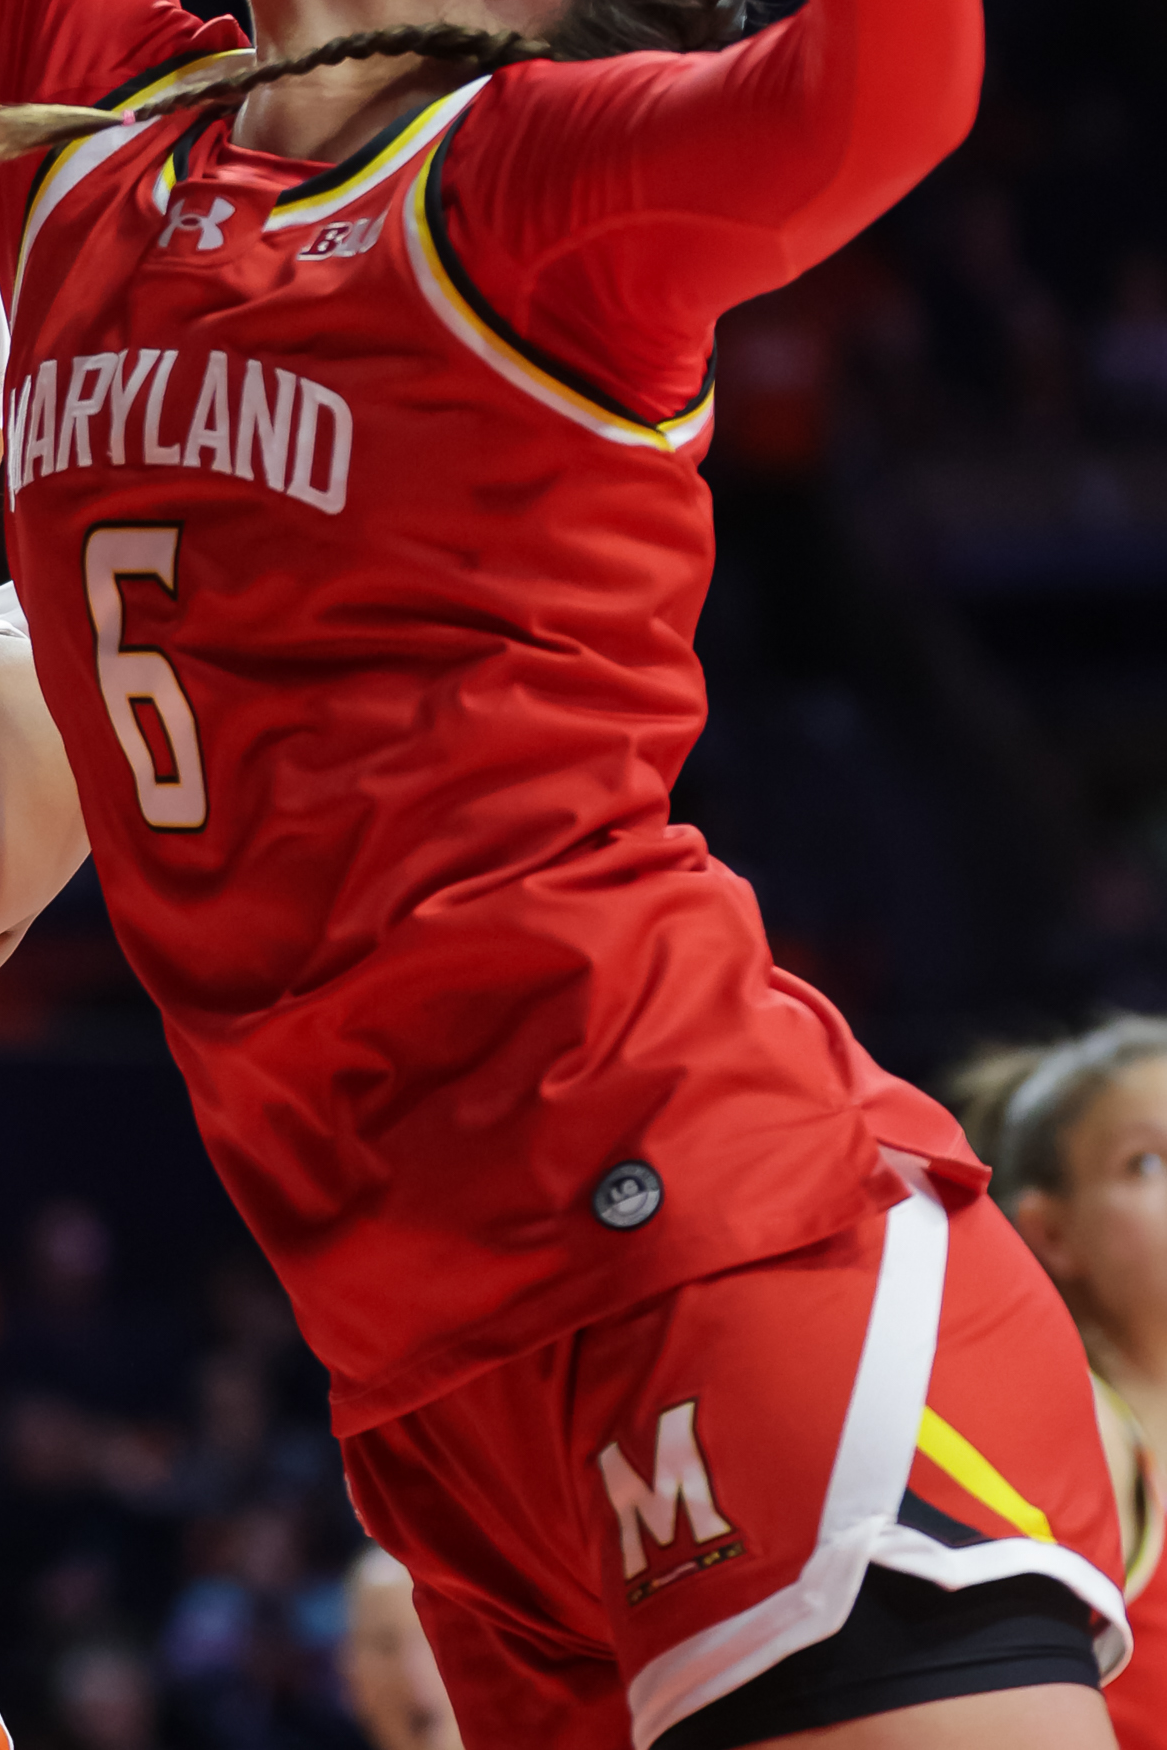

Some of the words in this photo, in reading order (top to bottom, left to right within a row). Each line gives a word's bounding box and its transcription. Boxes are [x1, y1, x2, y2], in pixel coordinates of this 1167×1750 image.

[7, 349, 354, 515] MARYLAND
[83, 520, 209, 834] 6
[598, 1399, 733, 1582] M
